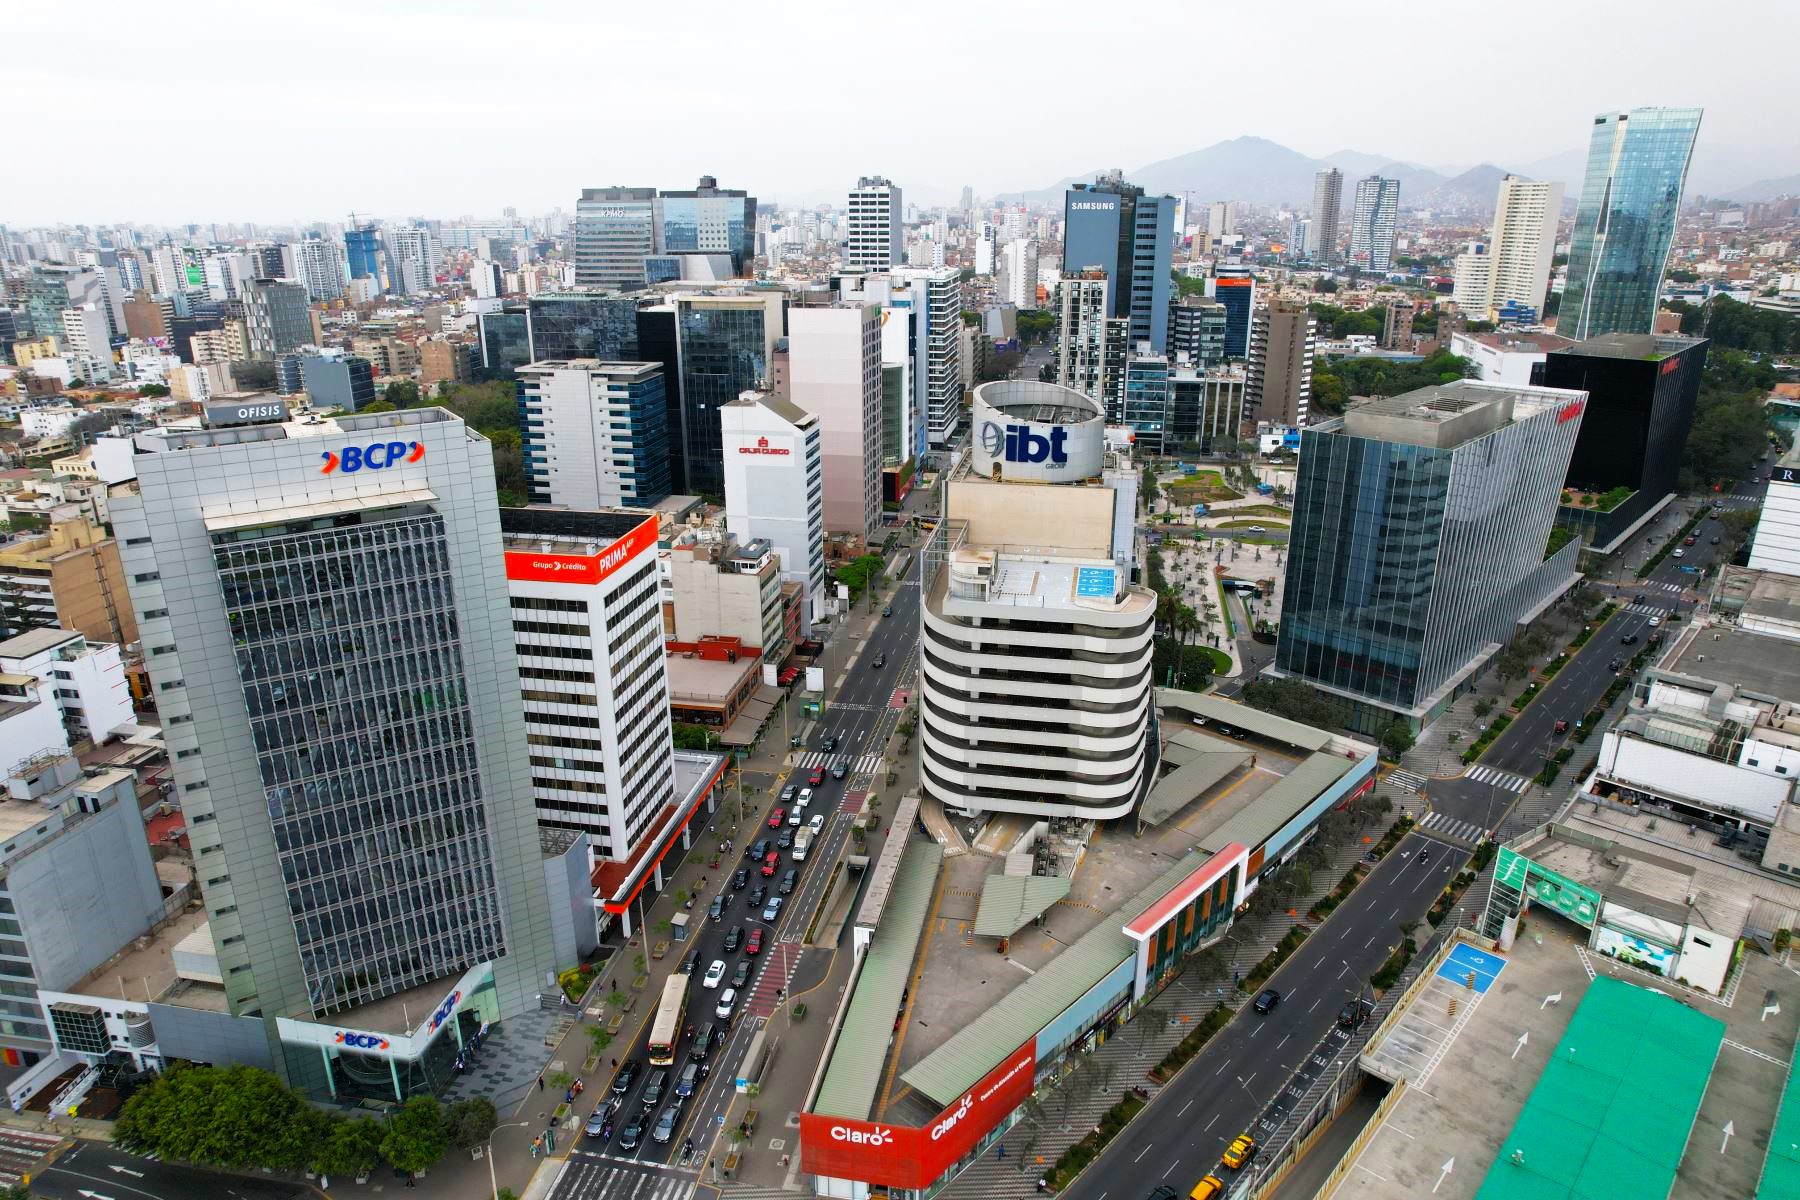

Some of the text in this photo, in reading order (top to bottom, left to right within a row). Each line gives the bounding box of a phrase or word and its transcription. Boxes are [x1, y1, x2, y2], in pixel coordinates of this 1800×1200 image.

[1071, 202, 1115, 210] SAMSUNG
[238, 405, 280, 418] OFISIS
[1005, 424, 1068, 463] ibt
[341, 441, 407, 473] BCP
[1782, 469, 1794, 481] R
[532, 561, 586, 571] Grupo Crédito
[600, 543, 628, 575] PRIMA
[344, 1031, 381, 1049] BCP
[1334, 1029, 1350, 1040] TAXI
[1312, 1054, 1328, 1067] TAXI
[1286, 1085, 1304, 1099] TAXI
[931, 1098, 970, 1140] Claro
[1260, 1118, 1277, 1132] TAXI
[831, 1126, 886, 1146] Claro
